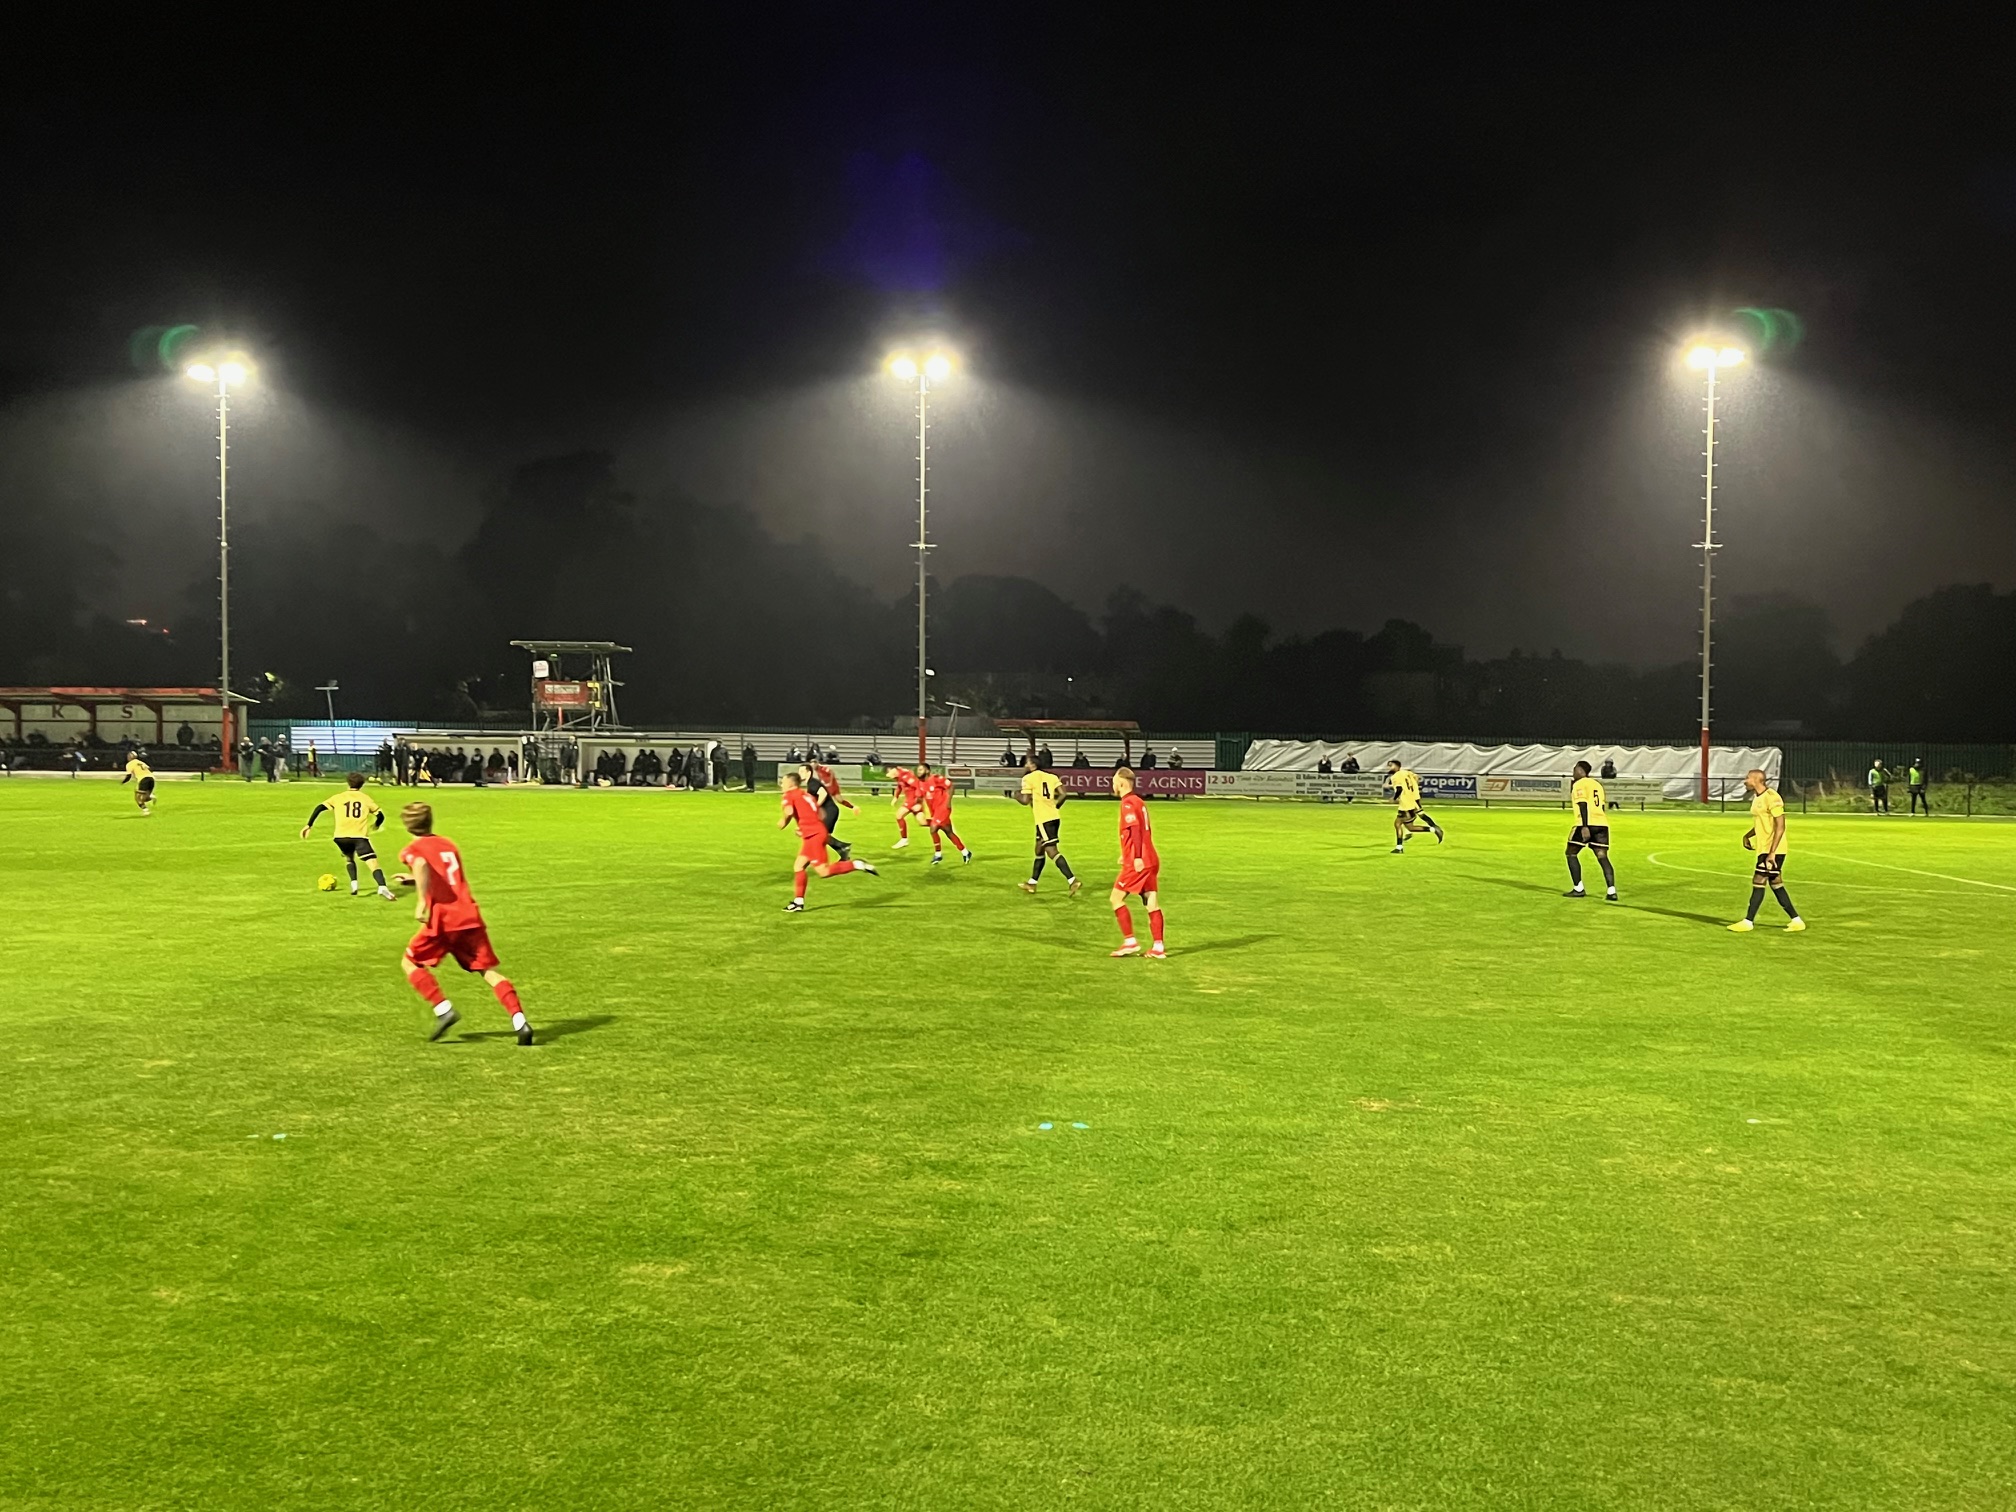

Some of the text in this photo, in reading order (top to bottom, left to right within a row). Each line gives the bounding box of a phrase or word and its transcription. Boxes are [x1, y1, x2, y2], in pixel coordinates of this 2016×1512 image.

[52, 704, 64, 719] K
[121, 705, 133, 719] S
[1042, 781, 1051, 800] 4
[1060, 775, 1203, 789] GLEY ESE AGENTS
[1593, 789, 1600, 807] 5
[344, 801, 362, 818] 18
[439, 851, 459, 886] 7
